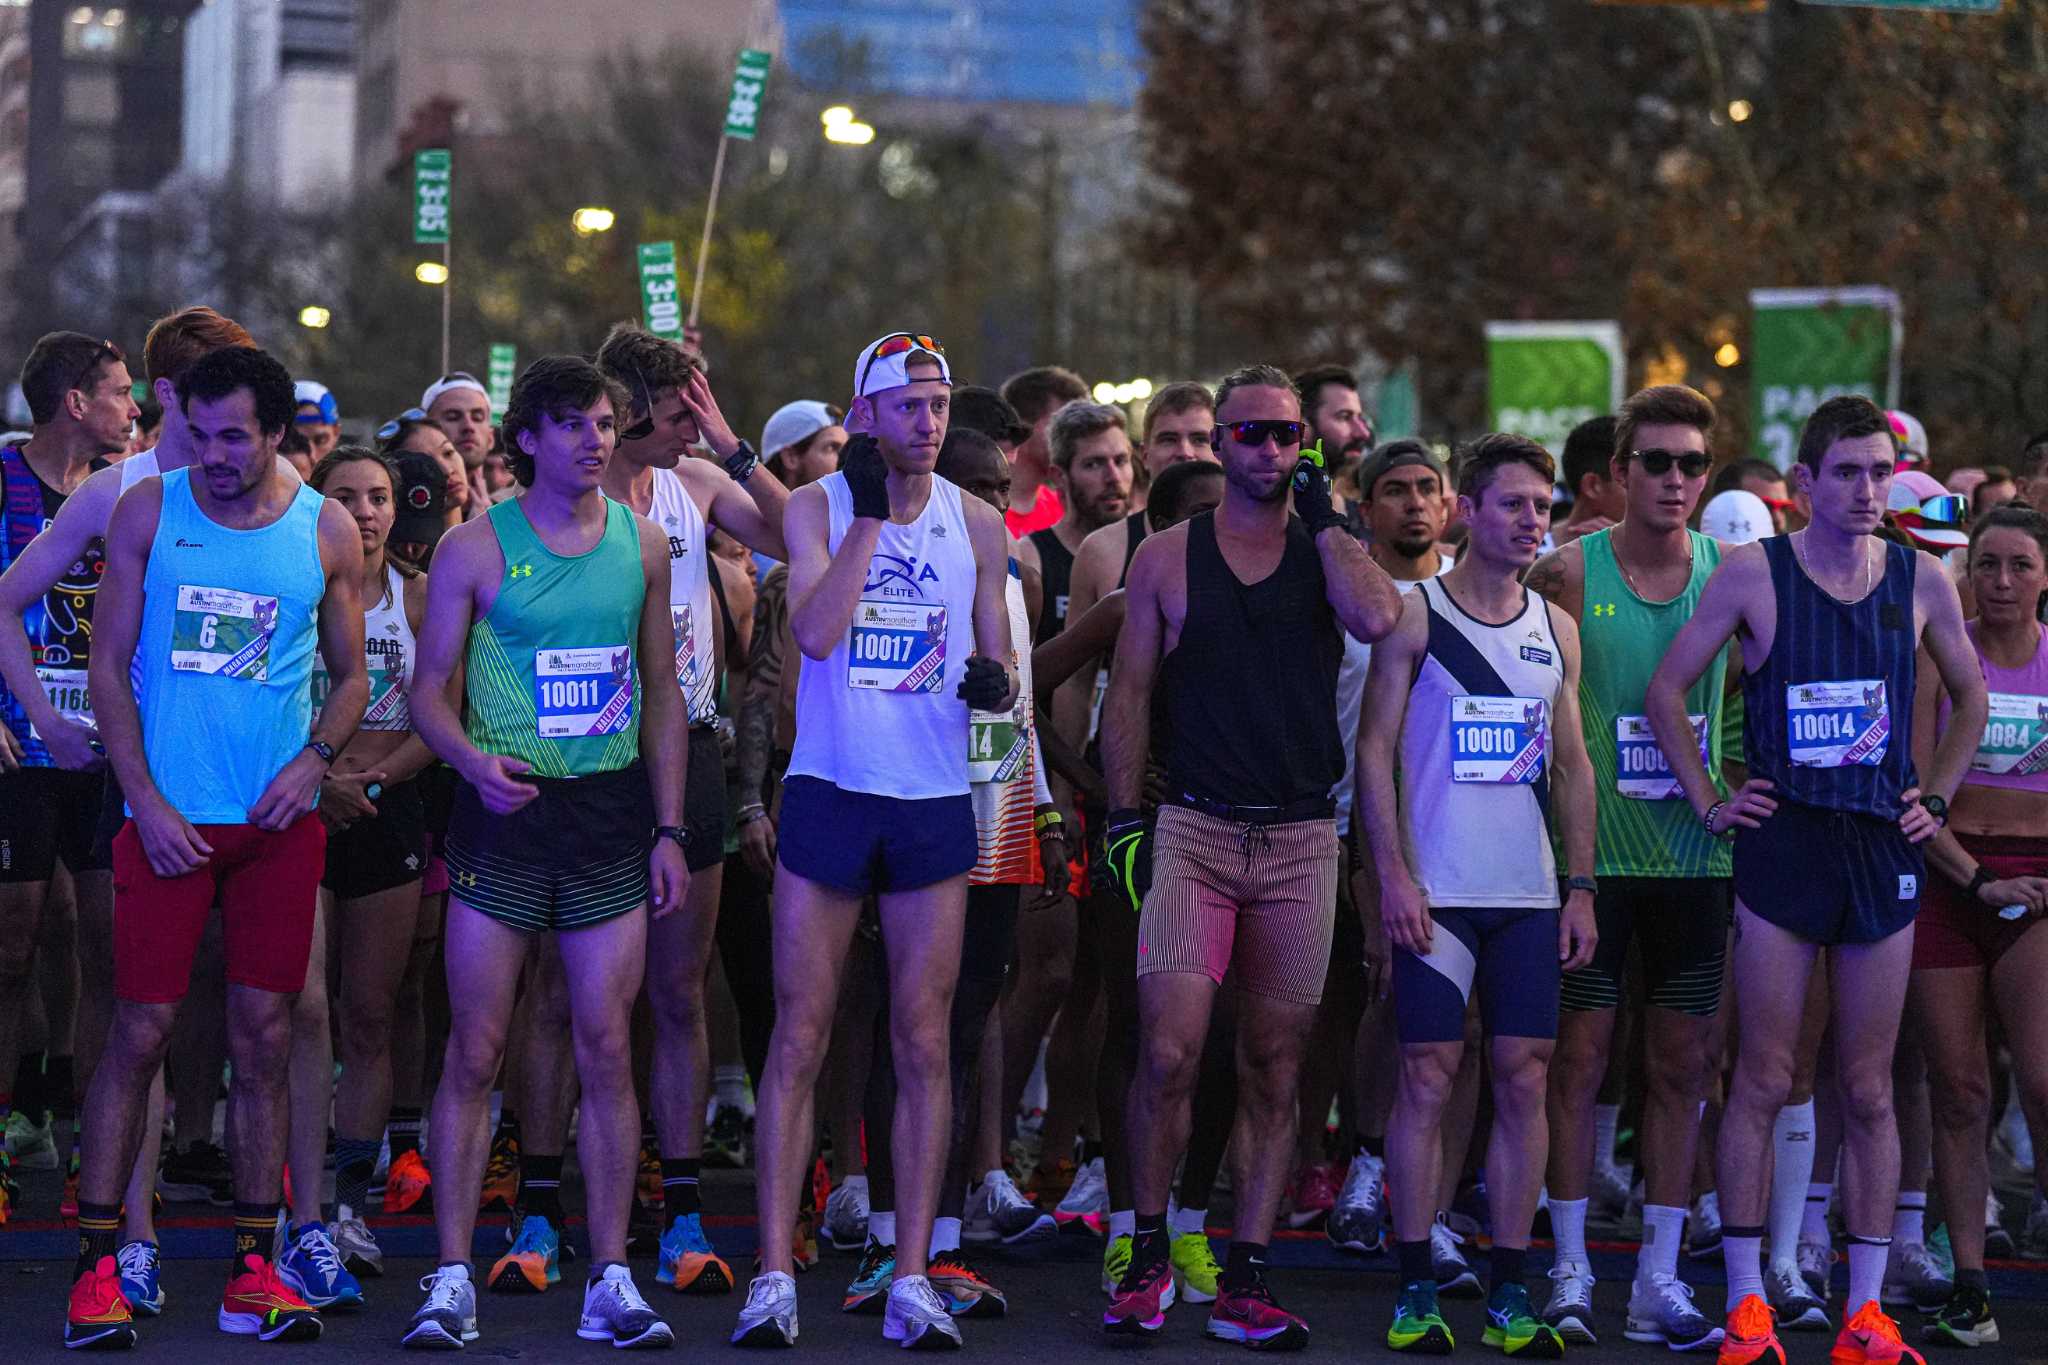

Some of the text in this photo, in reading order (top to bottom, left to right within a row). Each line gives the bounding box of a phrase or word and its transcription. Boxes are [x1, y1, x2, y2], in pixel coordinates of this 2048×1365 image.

[646, 279, 680, 332] 3:00
[883, 586, 915, 598] ELITE
[200, 614, 218, 649] 6
[222, 647, 256, 676] MARATHON
[854, 632, 914, 662] 10017
[905, 651, 941, 689] HALF ELITE
[924, 672, 940, 690] MEN
[541, 679, 598, 709] 10011
[595, 690, 629, 732] HALF ELITE
[614, 711, 629, 730] MEN
[1457, 727, 1516, 753] 10010
[1792, 712, 1856, 741] 10014
[1847, 724, 1884, 762] HALF ELITE
[1508, 743, 1541, 781] HALF ELITE
